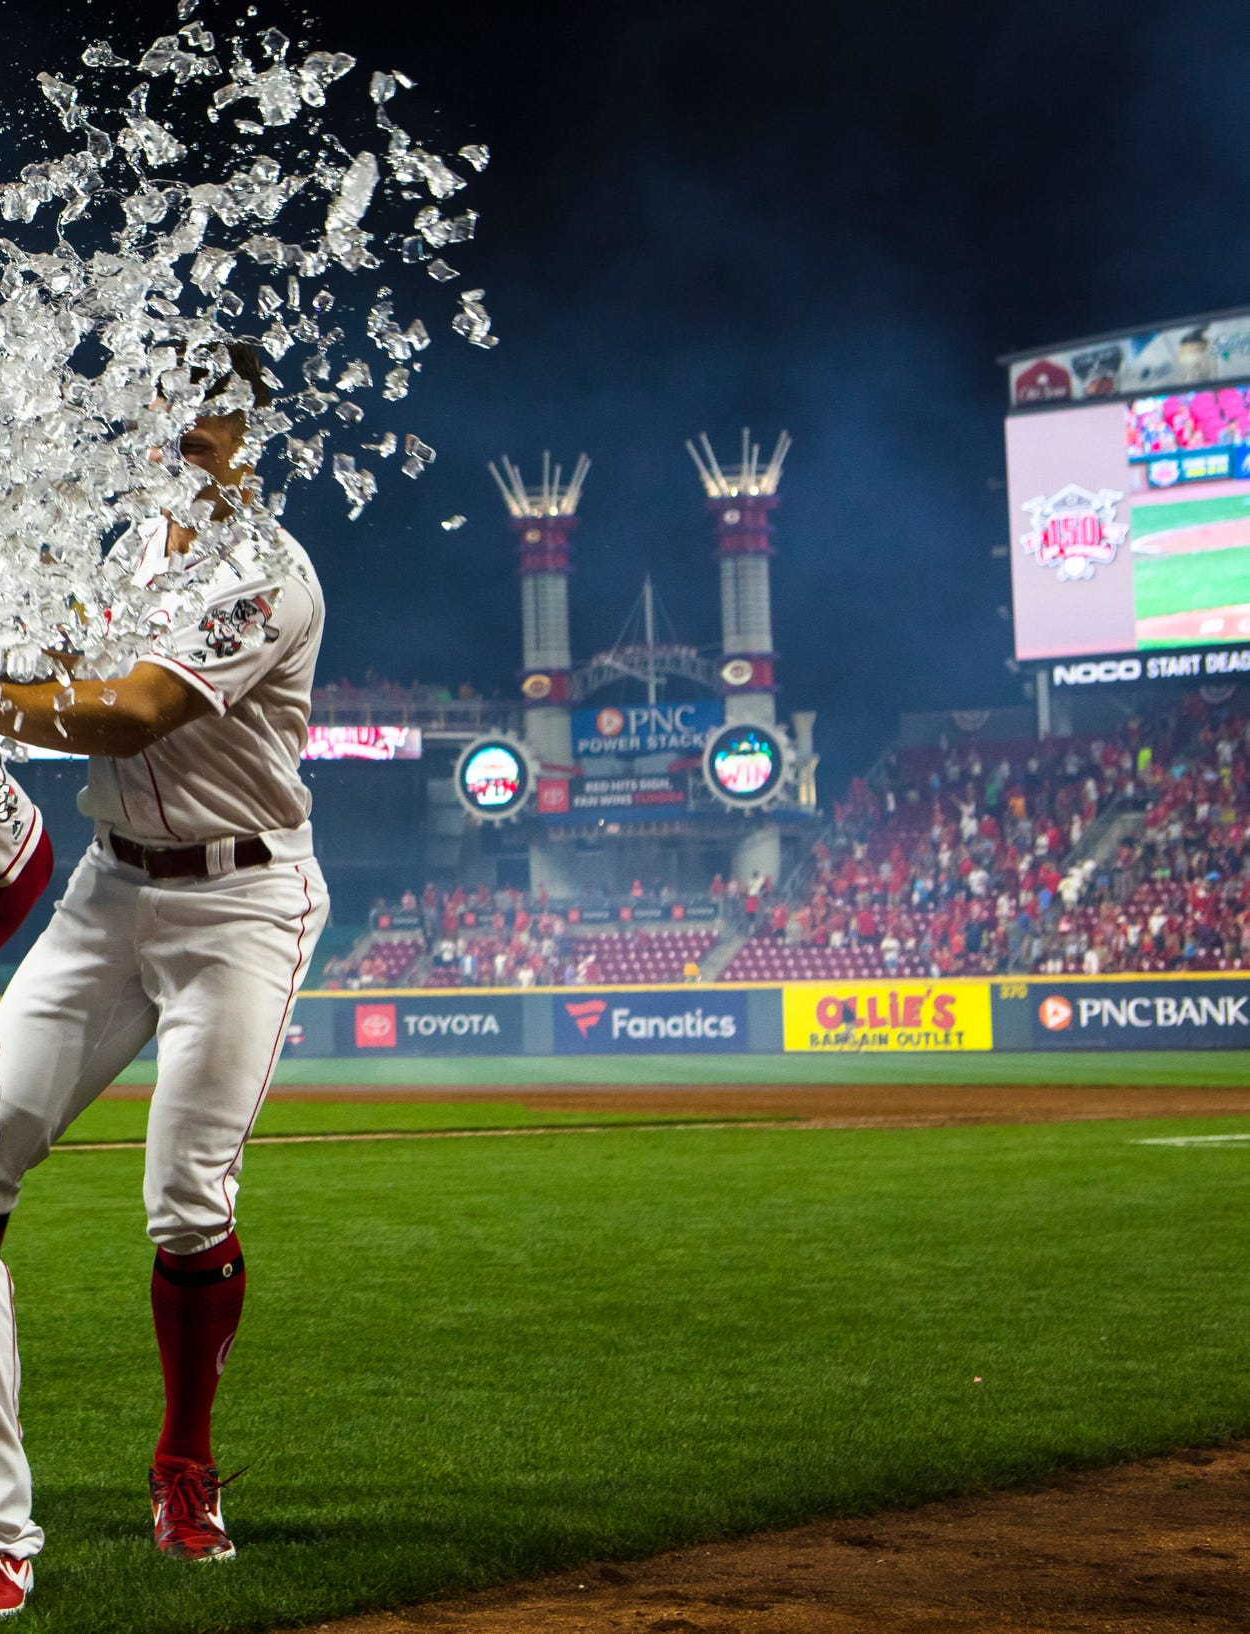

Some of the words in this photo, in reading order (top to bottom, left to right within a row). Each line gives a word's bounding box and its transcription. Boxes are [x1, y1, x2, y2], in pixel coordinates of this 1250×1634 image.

[1053, 658, 1142, 686] NOCO
[1146, 654, 1202, 678] START
[628, 704, 696, 735] PNC
[577, 736, 640, 754] POWER
[646, 732, 709, 751] STACK
[611, 1008, 737, 1039] Fanatics
[816, 987, 957, 1031] OLLIE'S
[403, 1013, 501, 1037] TOYOTA
[896, 1031, 965, 1047] OUTLET
